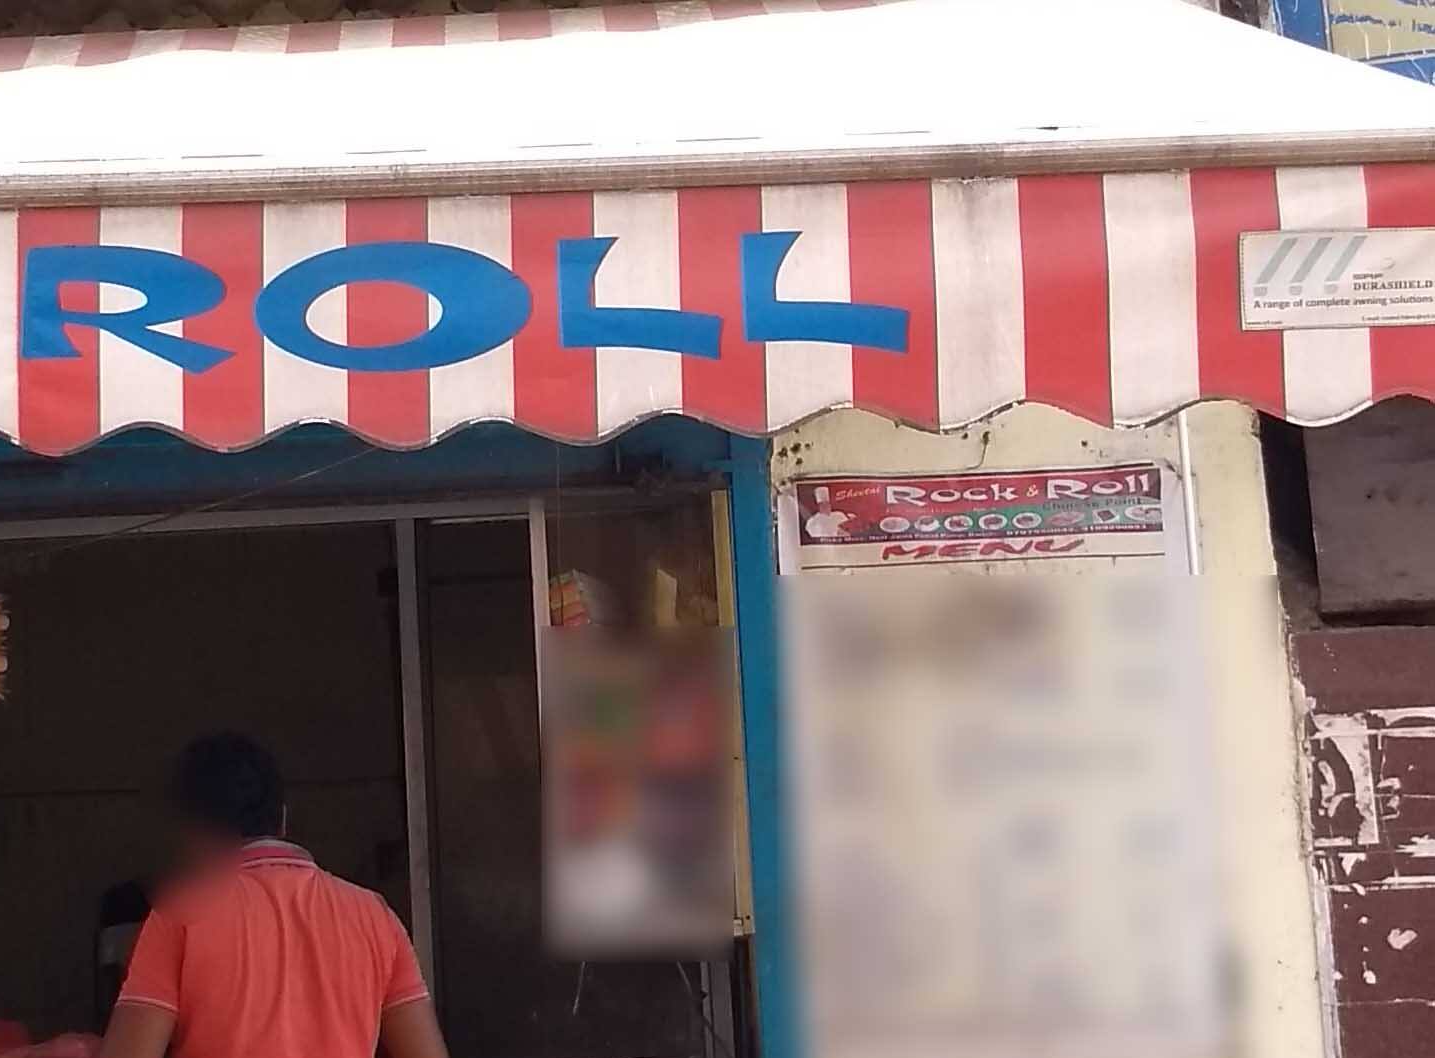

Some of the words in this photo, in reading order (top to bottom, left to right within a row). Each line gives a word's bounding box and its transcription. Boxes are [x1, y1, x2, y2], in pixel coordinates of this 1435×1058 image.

[1353, 280, 1434, 291] DURASHIELD
[22, 230, 909, 373] ROLL
[1253, 300, 1261, 309] A
[1263, 300, 1291, 310] range
[1293, 298, 1303, 308] of
[1305, 298, 1350, 308] complete
[1389, 295, 1434, 305] solutions
[886, 483, 1019, 507] Rock
[1026, 484, 1039, 498] &
[1047, 473, 1149, 500] Roll
[883, 538, 1084, 560] MENU
